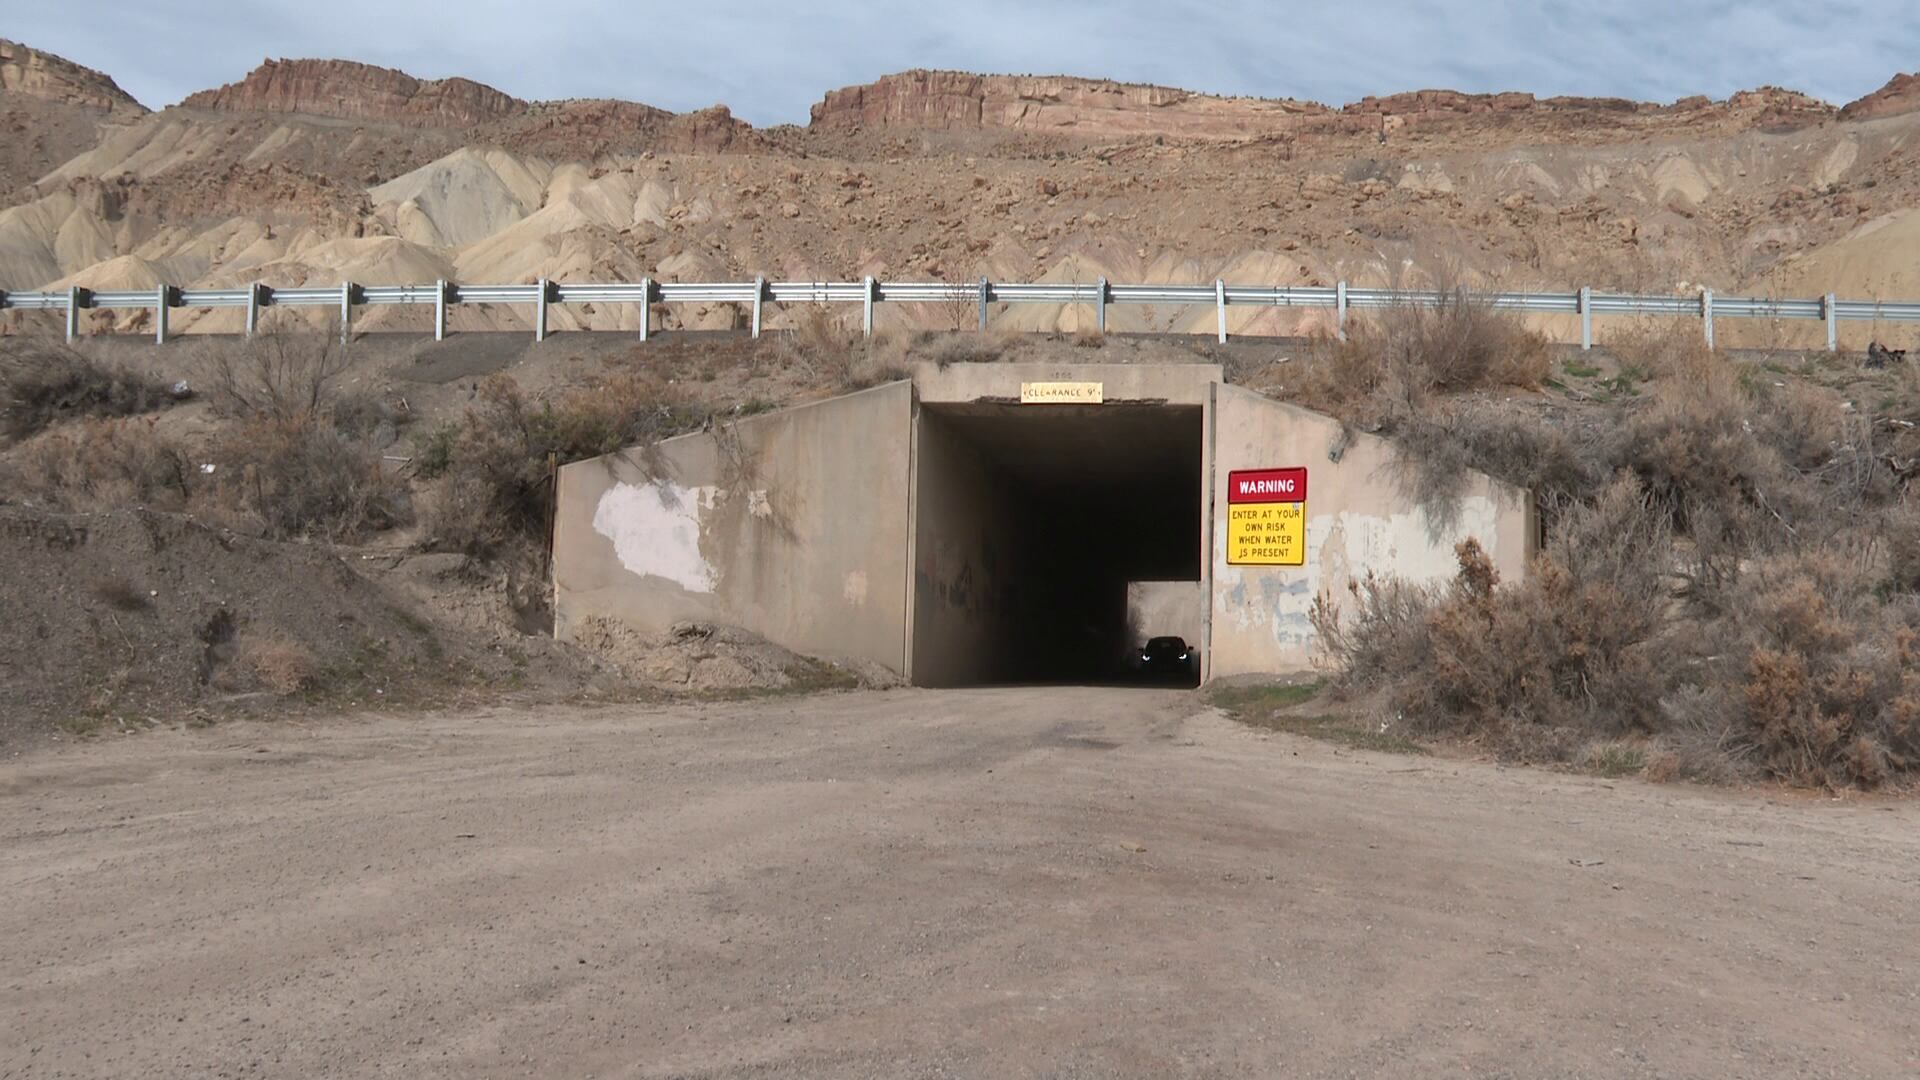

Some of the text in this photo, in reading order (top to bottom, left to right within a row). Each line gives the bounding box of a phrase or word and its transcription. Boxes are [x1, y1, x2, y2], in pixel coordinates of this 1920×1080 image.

[1239, 479, 1295, 494] WARNING
[1232, 509, 1300, 519] ENTER AT YOUR
[1245, 522, 1286, 532] OWN RISK
[1238, 535, 1292, 544] WHEN WATER
[1251, 548, 1289, 557] PRESENT
